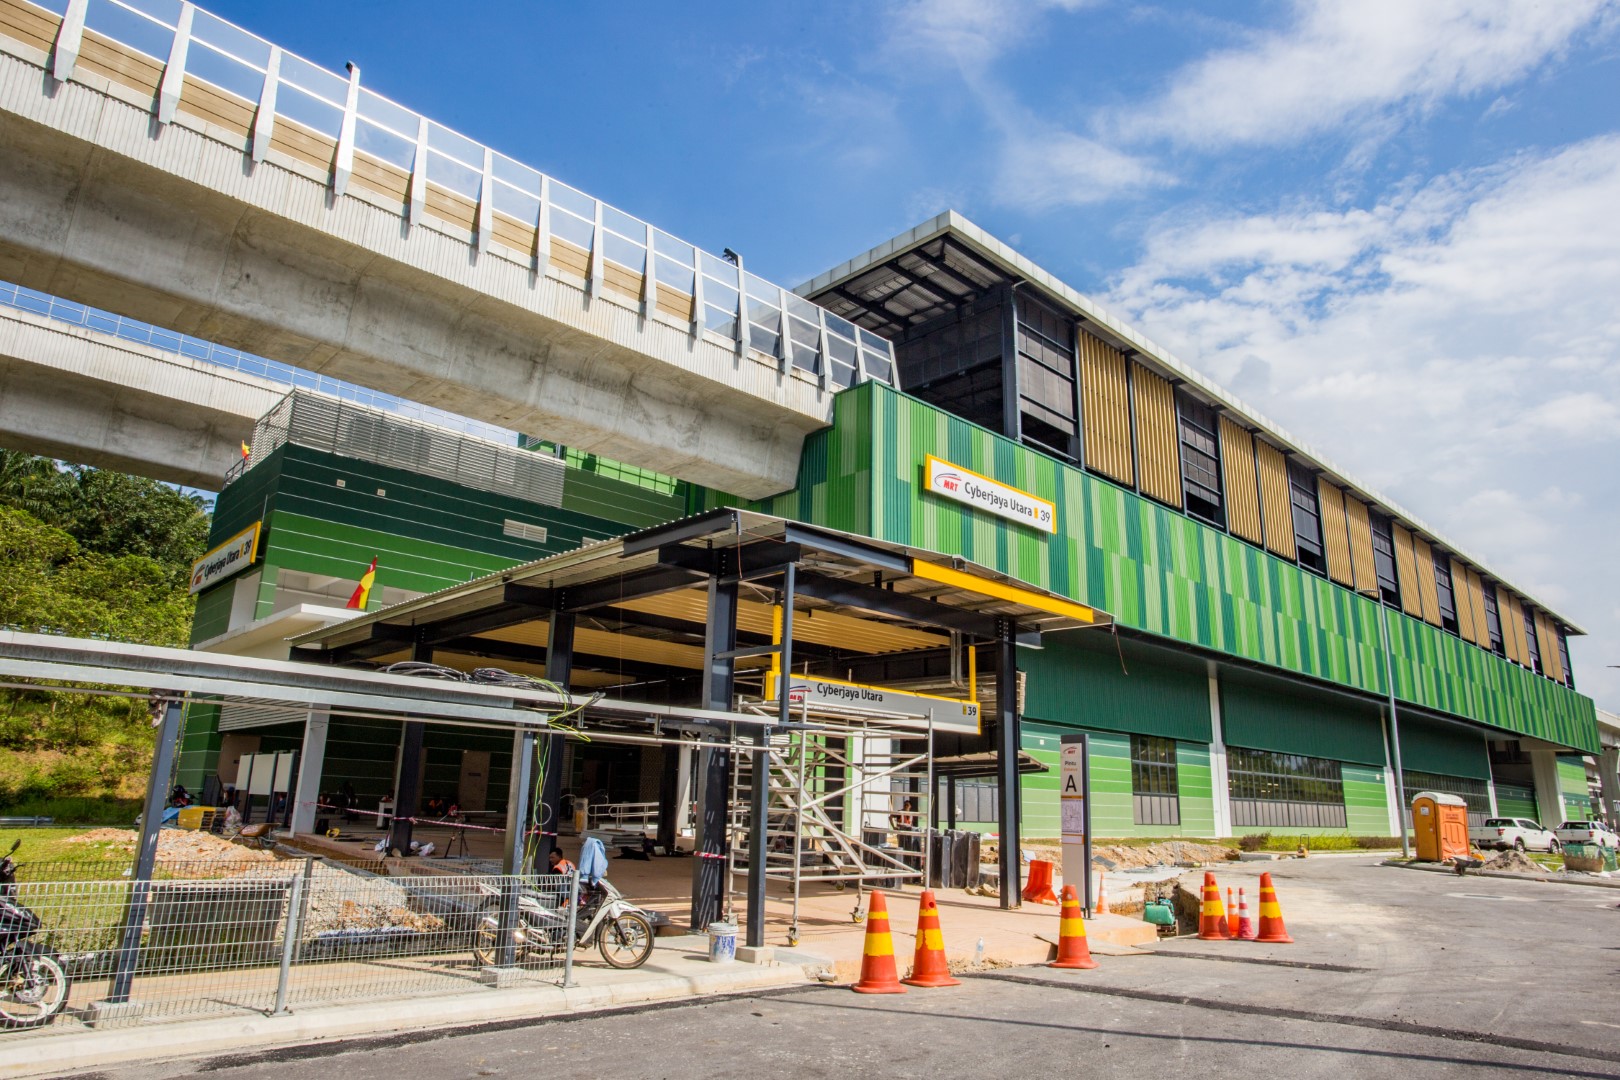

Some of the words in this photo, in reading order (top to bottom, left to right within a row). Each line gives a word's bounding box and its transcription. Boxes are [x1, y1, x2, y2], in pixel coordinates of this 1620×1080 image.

[943, 480, 959, 492] MRT
[964, 482, 1008, 509] Cyberjaya
[1010, 498, 1033, 517] Utara
[1040, 510, 1051, 523] 39
[817, 683, 860, 701] Cyberjaya
[861, 689, 883, 702] Utara
[967, 706, 977, 716] 39
[1065, 774, 1077, 792] A
